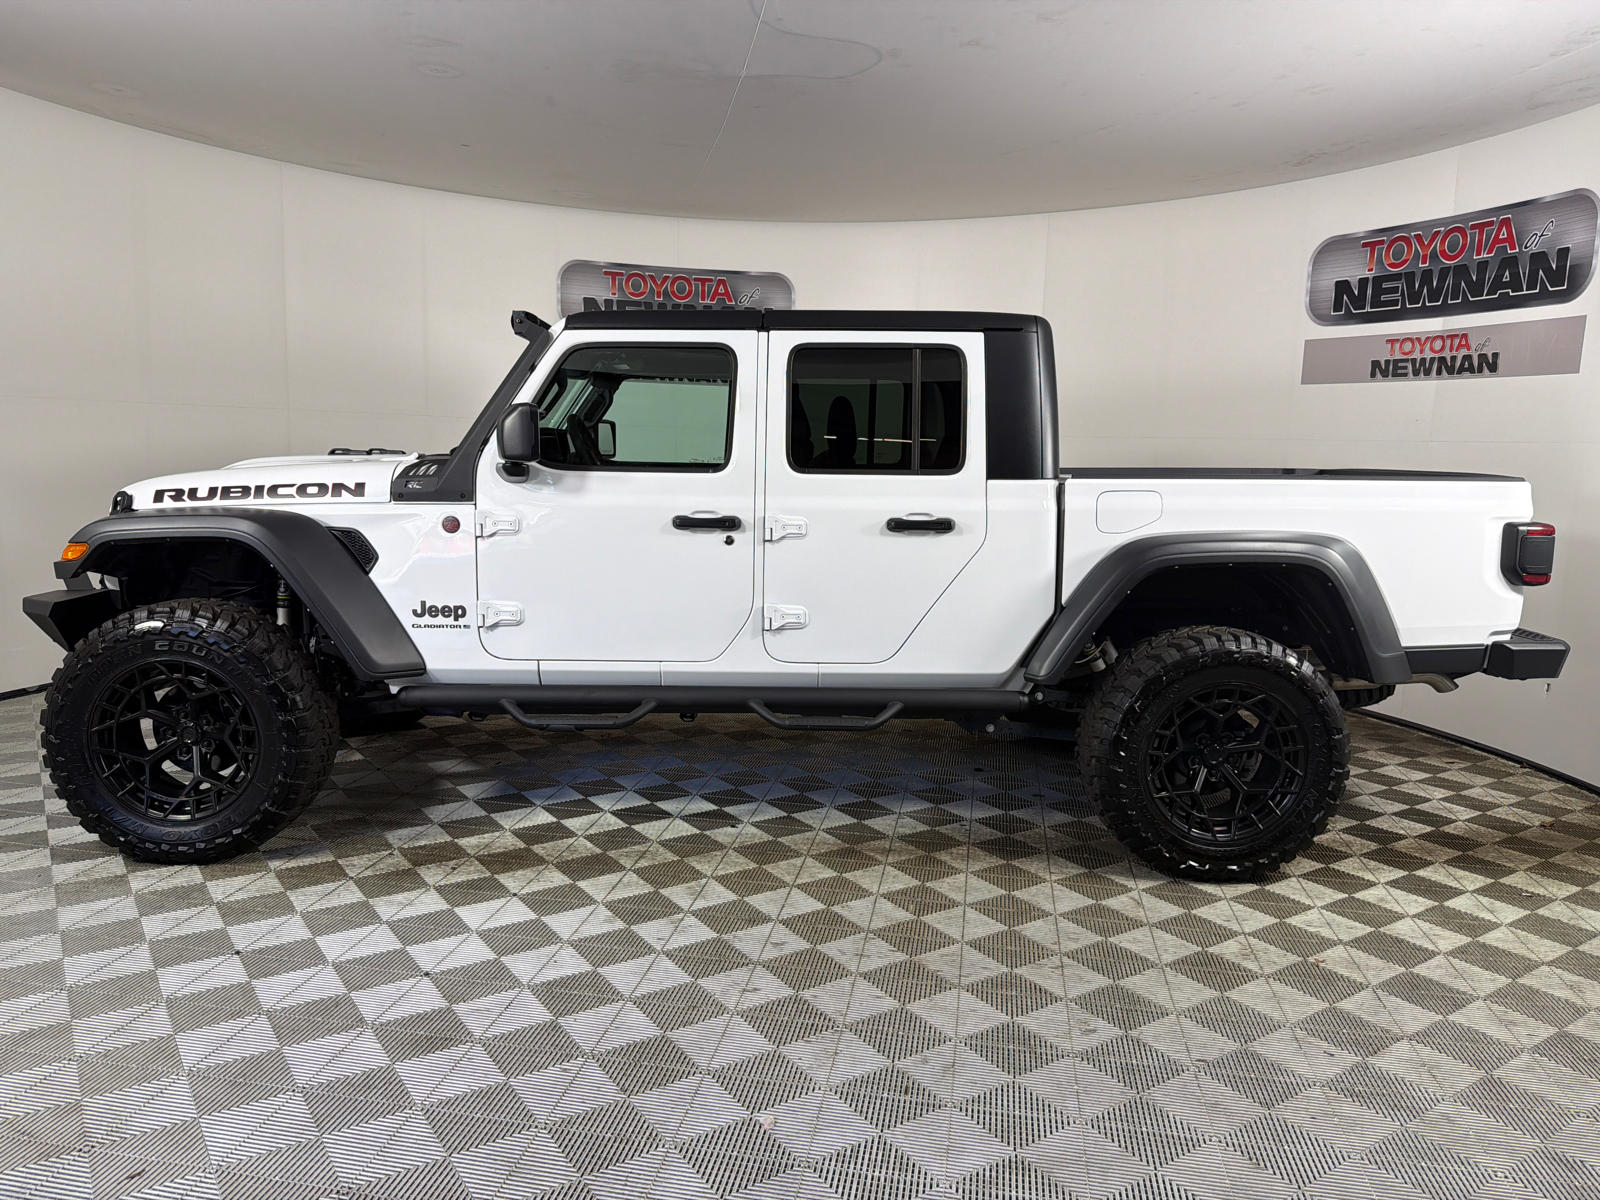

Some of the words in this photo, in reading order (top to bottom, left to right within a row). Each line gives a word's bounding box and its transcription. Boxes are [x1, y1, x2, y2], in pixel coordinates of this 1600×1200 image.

[1361, 215, 1519, 273] TOYOTA
[1523, 219, 1555, 251] of
[603, 270, 735, 304] TOYOTA
[738, 287, 760, 305] of
[1331, 245, 1572, 315] NEWNAN
[1385, 332, 1472, 357] TOYOTA
[1475, 337, 1491, 352] of
[1369, 352, 1499, 379] NEWNAN
[153, 482, 366, 503] RUBICON
[411, 600, 467, 622] Jeep
[87, 642, 143, 687] OPEN
